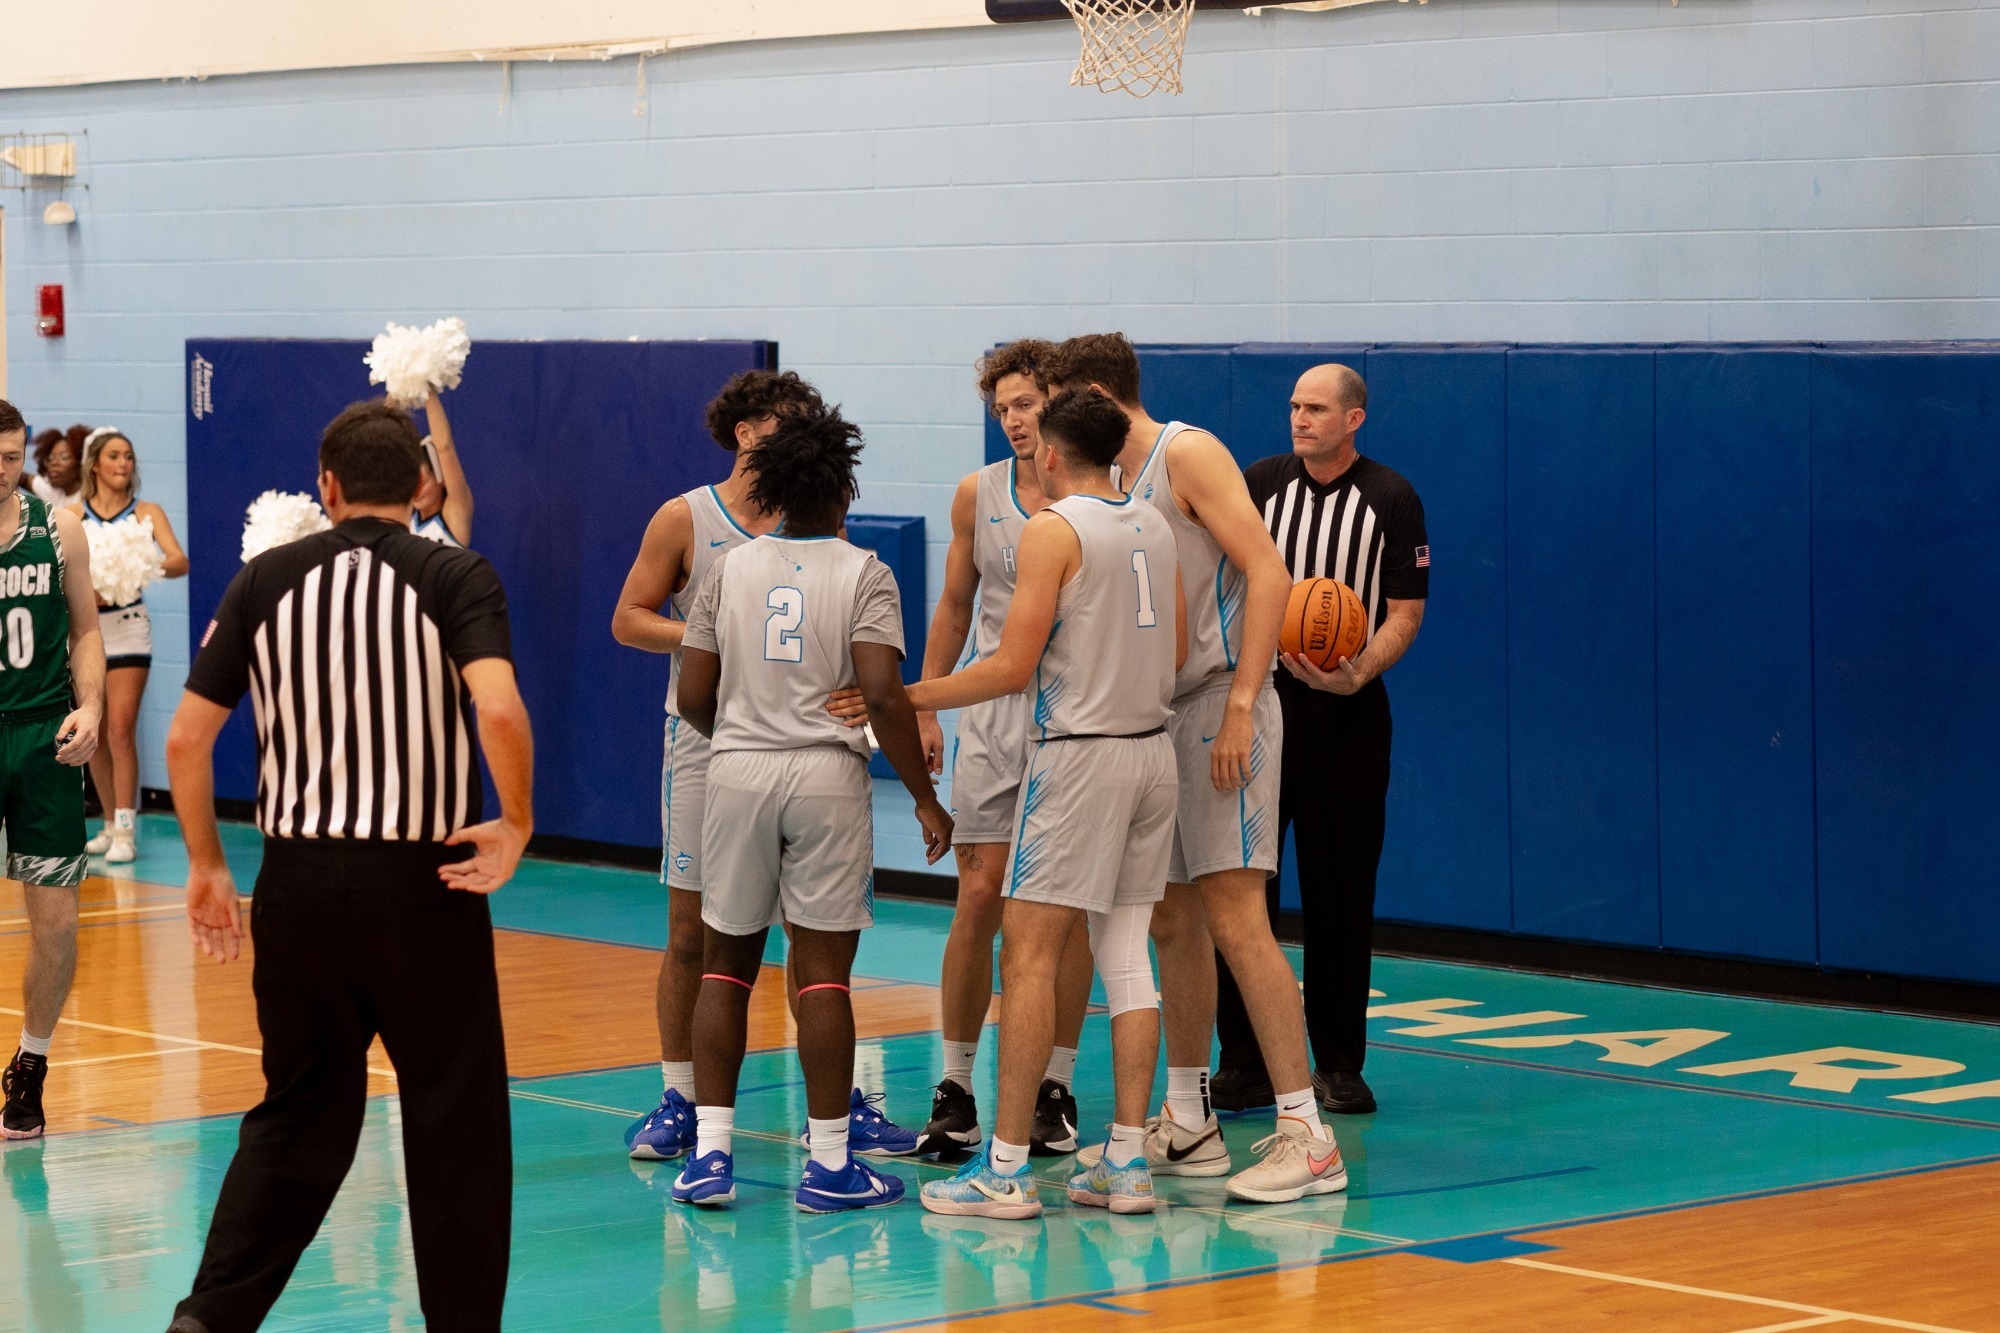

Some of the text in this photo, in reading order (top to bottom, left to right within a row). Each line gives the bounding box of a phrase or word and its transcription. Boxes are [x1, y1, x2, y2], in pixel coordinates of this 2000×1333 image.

[764, 585, 804, 663] 2
[1131, 550, 1156, 628] 1
[1310, 591, 1333, 650] Wilson
[0, 607, 34, 671] 0
[1298, 981, 2000, 1104] HAR
